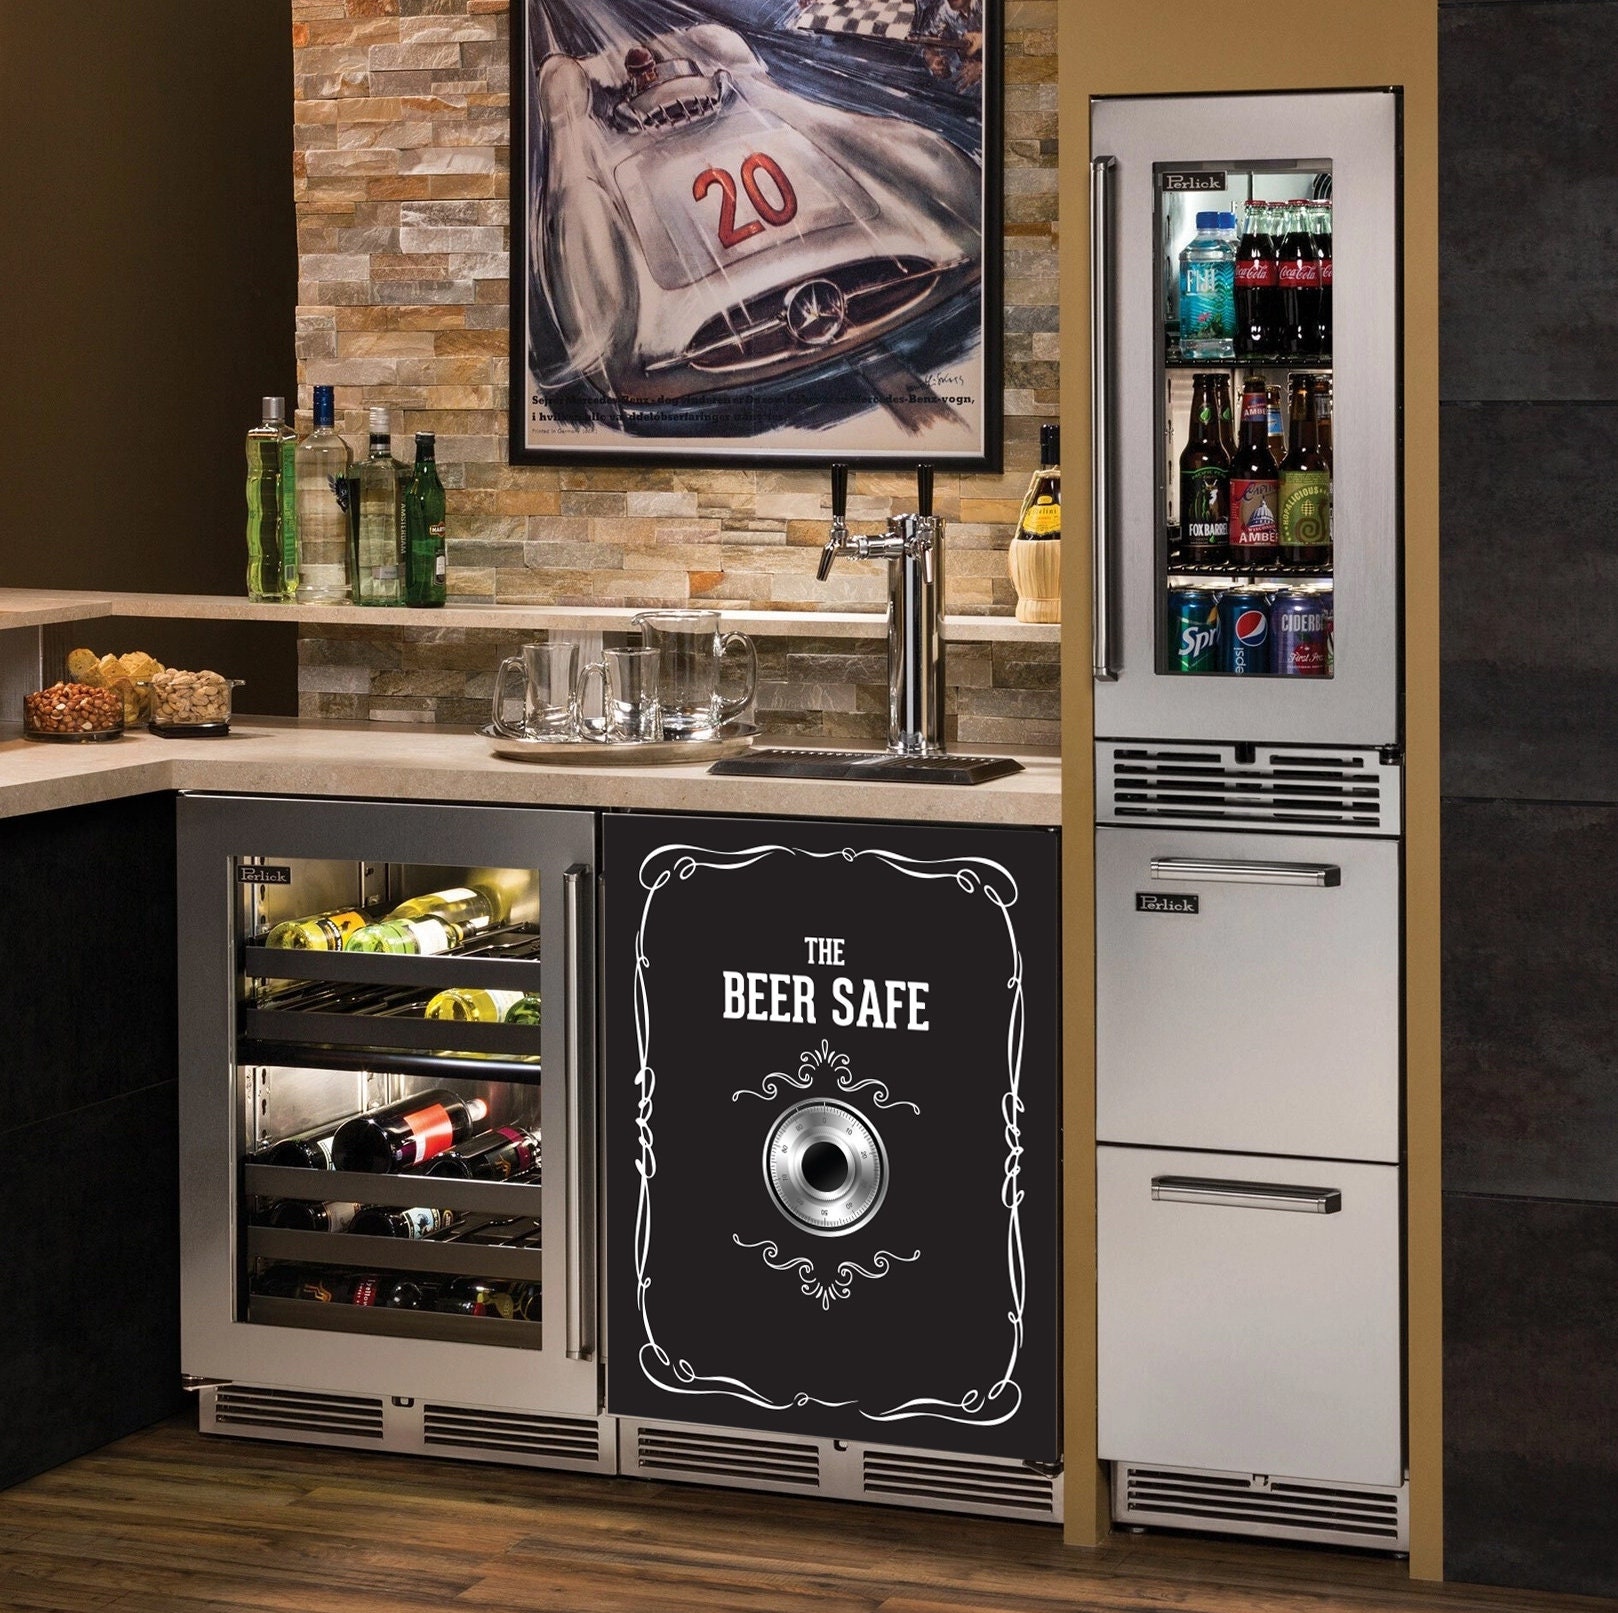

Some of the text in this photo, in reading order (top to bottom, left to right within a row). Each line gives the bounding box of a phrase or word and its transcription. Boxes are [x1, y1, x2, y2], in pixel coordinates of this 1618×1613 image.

[1166, 175, 1221, 189] Perlick
[692, 151, 798, 249] 20
[241, 867, 287, 882] Perlick
[1140, 895, 1195, 912] Perlick
[804, 936, 845, 966] THE
[722, 970, 930, 1031] BEER SAFE
